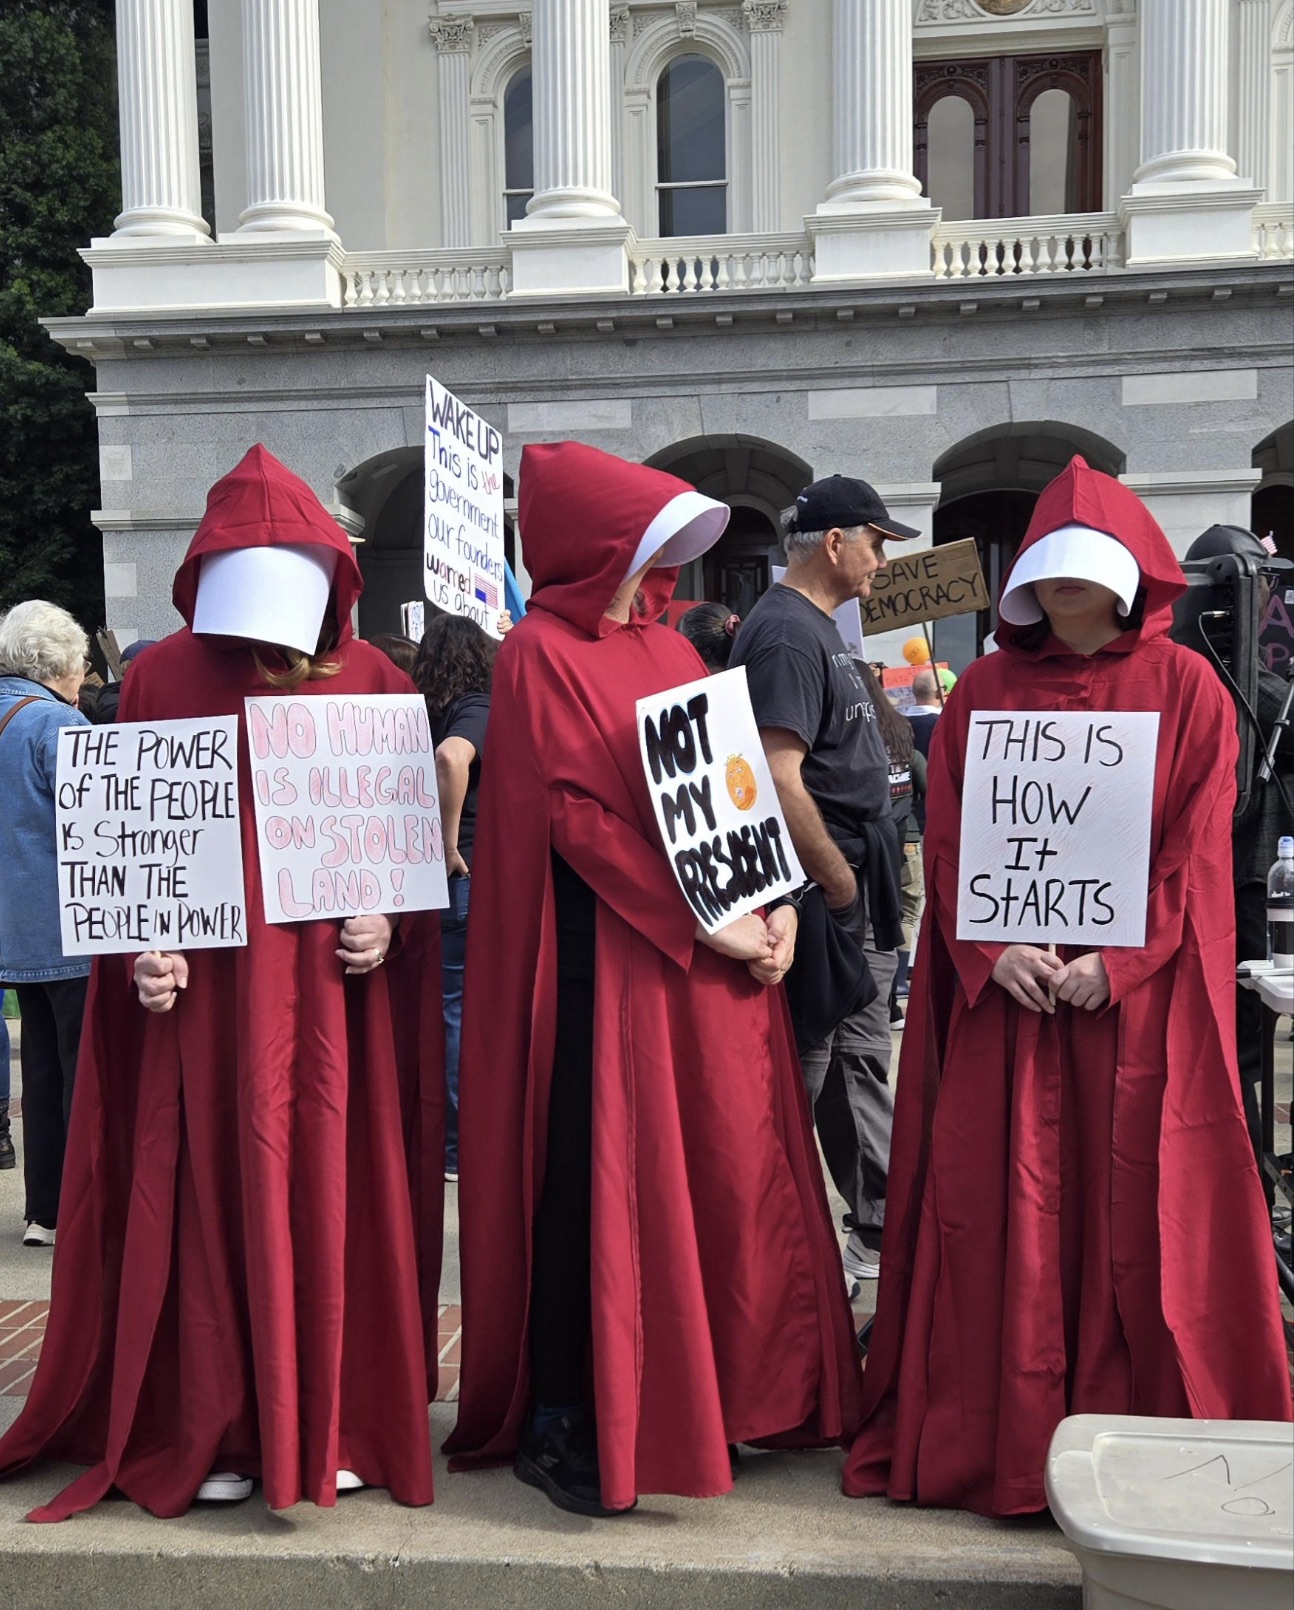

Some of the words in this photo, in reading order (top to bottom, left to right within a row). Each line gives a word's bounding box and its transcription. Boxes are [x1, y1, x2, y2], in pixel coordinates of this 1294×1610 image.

[428, 425, 462, 478] This
[467, 457, 479, 491] is
[482, 471, 501, 495] the
[429, 469, 500, 540] government
[428, 513, 454, 549] our
[457, 524, 503, 582] founders
[427, 552, 472, 597] warned
[434, 579, 449, 605] us
[64, 730, 120, 767] THE
[137, 730, 233, 771] POWER
[250, 703, 317, 759] NO
[326, 702, 429, 756] HUMAN
[644, 692, 713, 785] NOT
[975, 719, 1066, 762] THIS
[1084, 723, 1123, 767] IS
[101, 773, 141, 811] THE
[150, 778, 235, 821] PEOPLE
[255, 767, 298, 806] IS
[308, 765, 436, 809] ILLEGAL
[661, 775, 717, 845] MY
[992, 775, 1092, 825] HOW
[94, 820, 205, 868] Stronger
[265, 815, 316, 849] ON
[320, 814, 444, 868] STOLEN
[1004, 838, 1058, 872] It
[61, 861, 127, 898] THAN
[139, 863, 189, 899] THE
[674, 816, 792, 927] PRESIDENT
[64, 902, 150, 942] PEOPLE
[153, 909, 171, 935] IN
[176, 899, 243, 943] POWER
